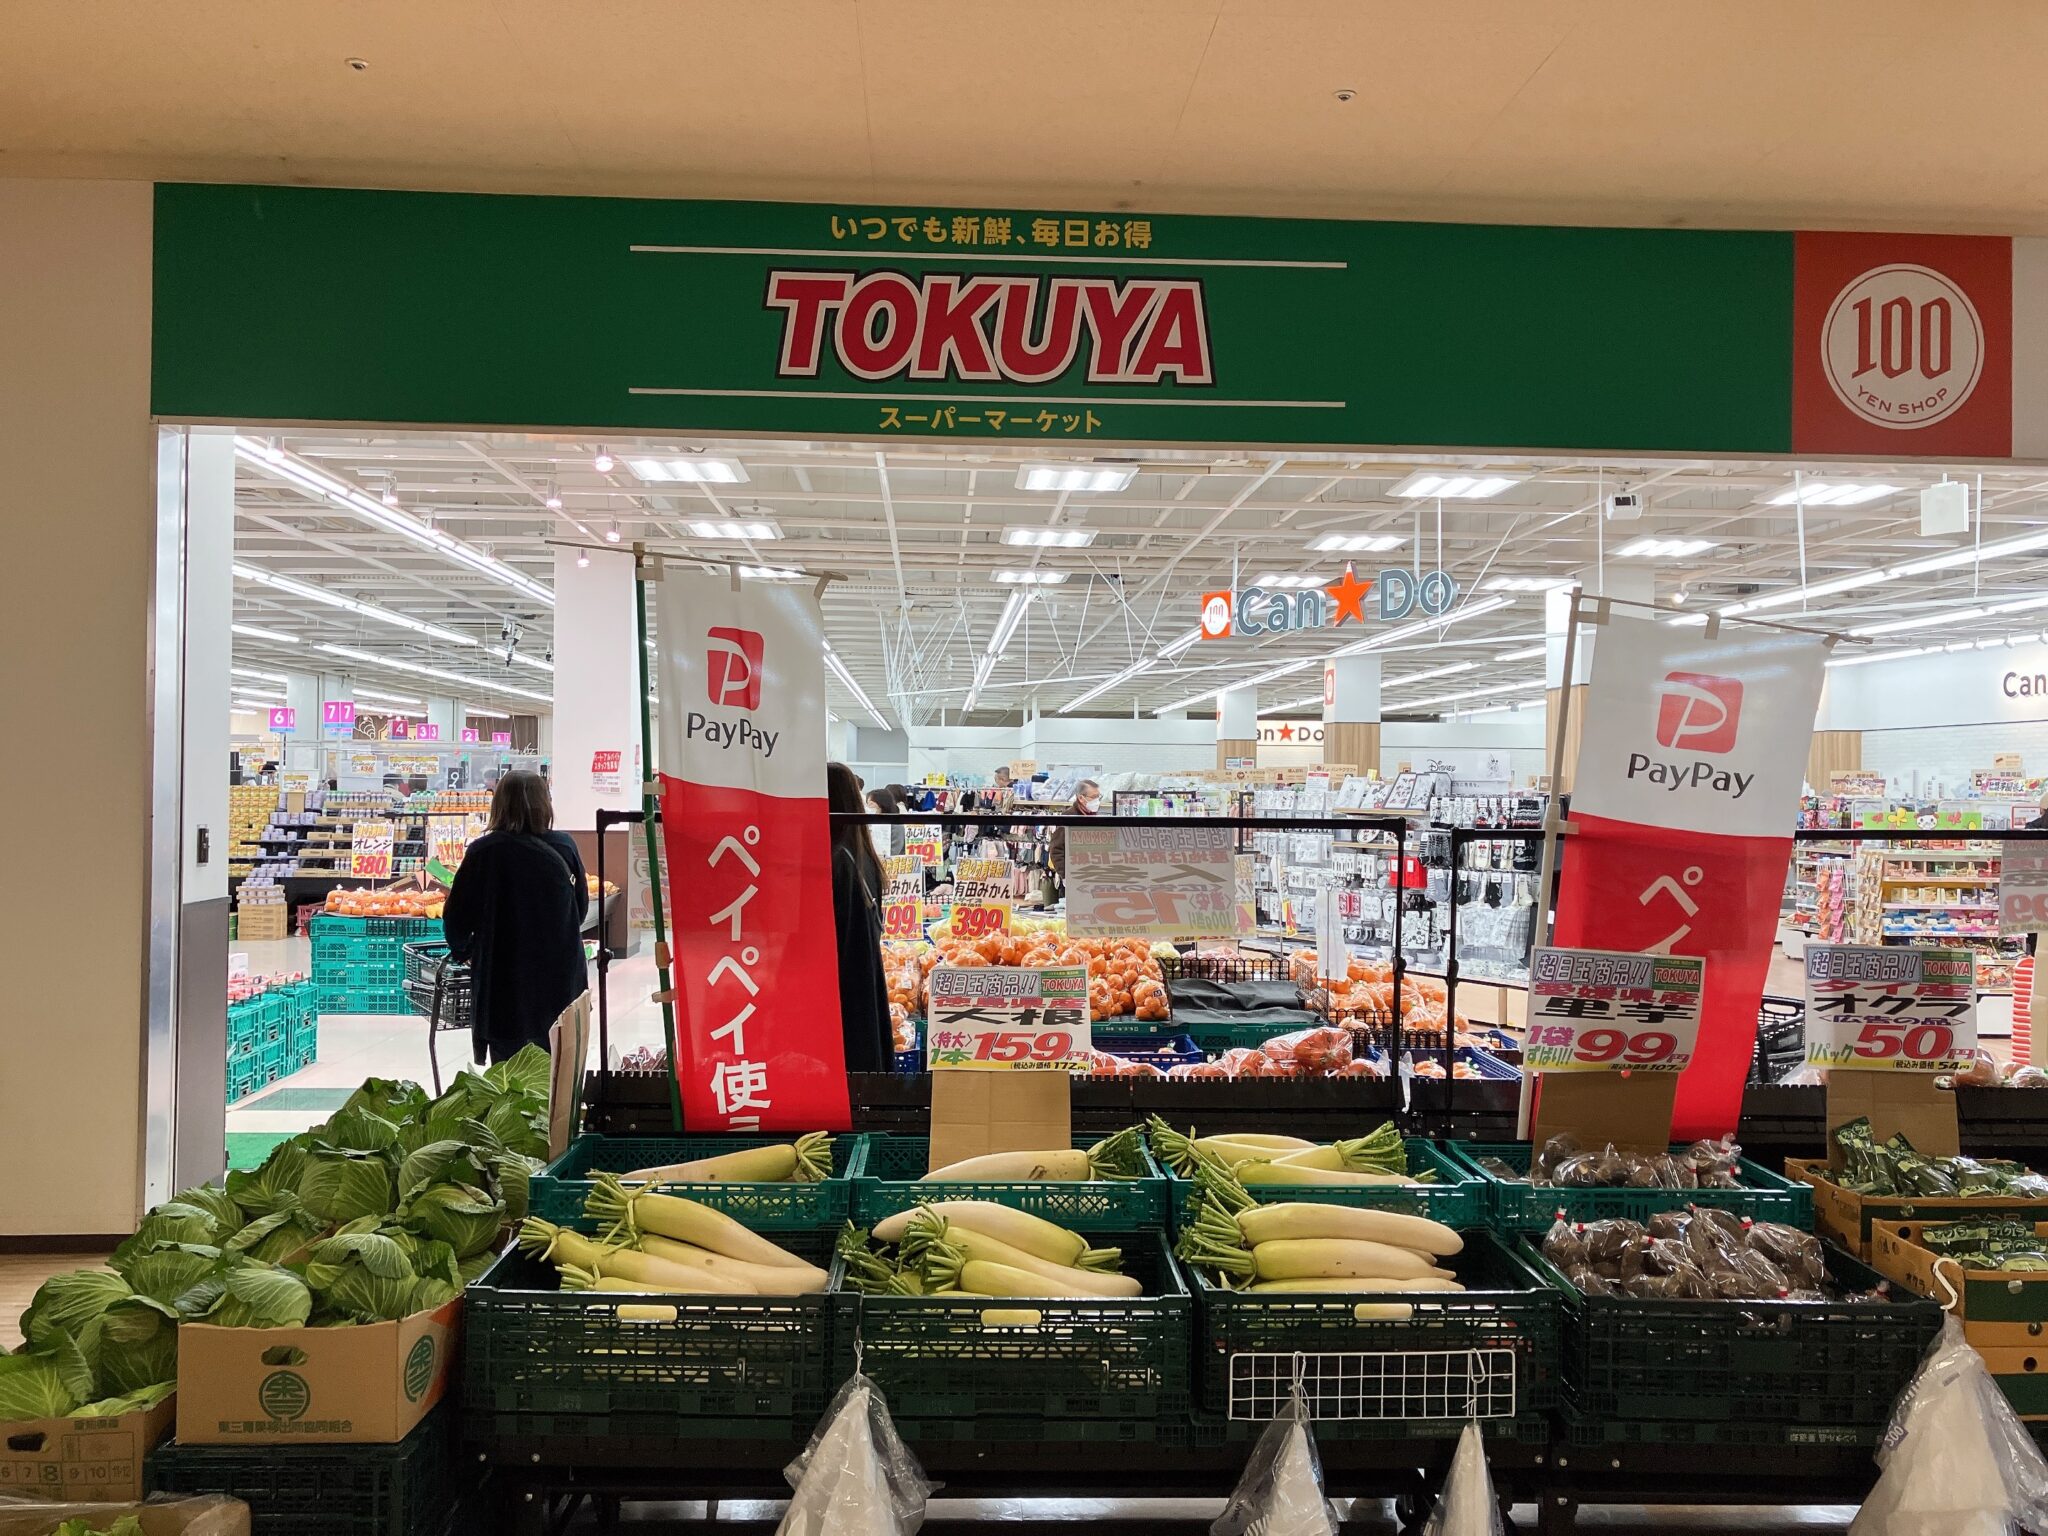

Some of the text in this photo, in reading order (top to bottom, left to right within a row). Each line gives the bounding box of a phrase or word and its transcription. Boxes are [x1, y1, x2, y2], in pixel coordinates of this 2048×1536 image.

[831, 215, 1153, 250] いつでも新鮮、毎日お得
[768, 269, 1213, 384] TOKUYA
[1852, 296, 1951, 380] 100
[1857, 385, 1949, 415] YEN SHOP
[879, 405, 1102, 434] スーパーマーケット
[1236, 587, 1325, 636] Can
[2003, 671, 2048, 698] Can
[686, 712, 779, 758] PayPay
[1627, 753, 1755, 798] PayPay
[353, 838, 393, 850] オレンジ
[954, 881, 1011, 899] 有田みかん
[1535, 955, 1700, 985] 超目玉商品!! TOKUYA
[1810, 951, 1971, 981] 超目玉商品!! TOKUYA
[934, 973, 1085, 996] 超目玉商品!! TOKUYA
[1810, 979, 1972, 998] タイ産
[934, 996, 1087, 1009] 徳島県産
[1813, 993, 1972, 1017] オクラ
[934, 1008, 1085, 1025] 大根
[1528, 1025, 1575, 1046] 1袋
[930, 1048, 971, 1065] 1本
[1808, 1042, 1854, 1063] 1パック
[1989, 1223, 2027, 1237] オクラ
